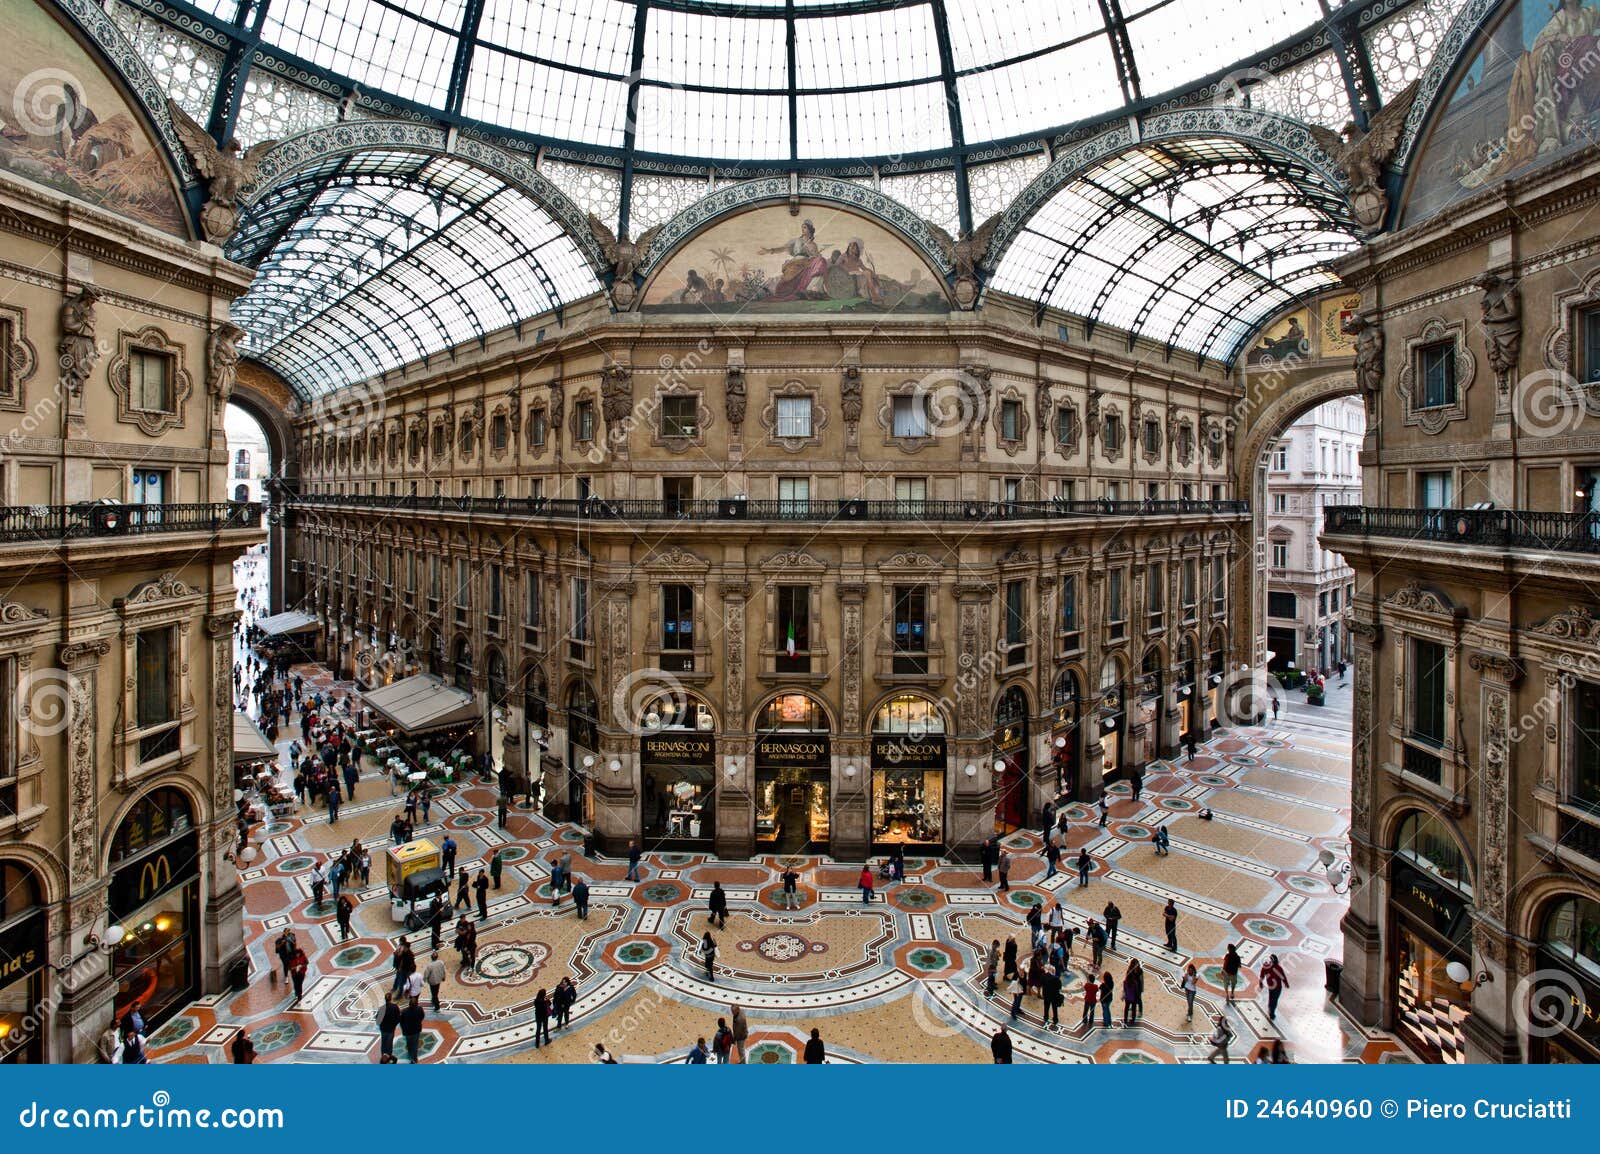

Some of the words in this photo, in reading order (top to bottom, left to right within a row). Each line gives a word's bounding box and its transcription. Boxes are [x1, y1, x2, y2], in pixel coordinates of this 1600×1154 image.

[647, 741, 710, 752] BERNASCONI
[761, 743, 825, 754] BERNASCONI
[877, 744, 941, 755] BERNASCONI
[0, 949, 35, 978] ld's
